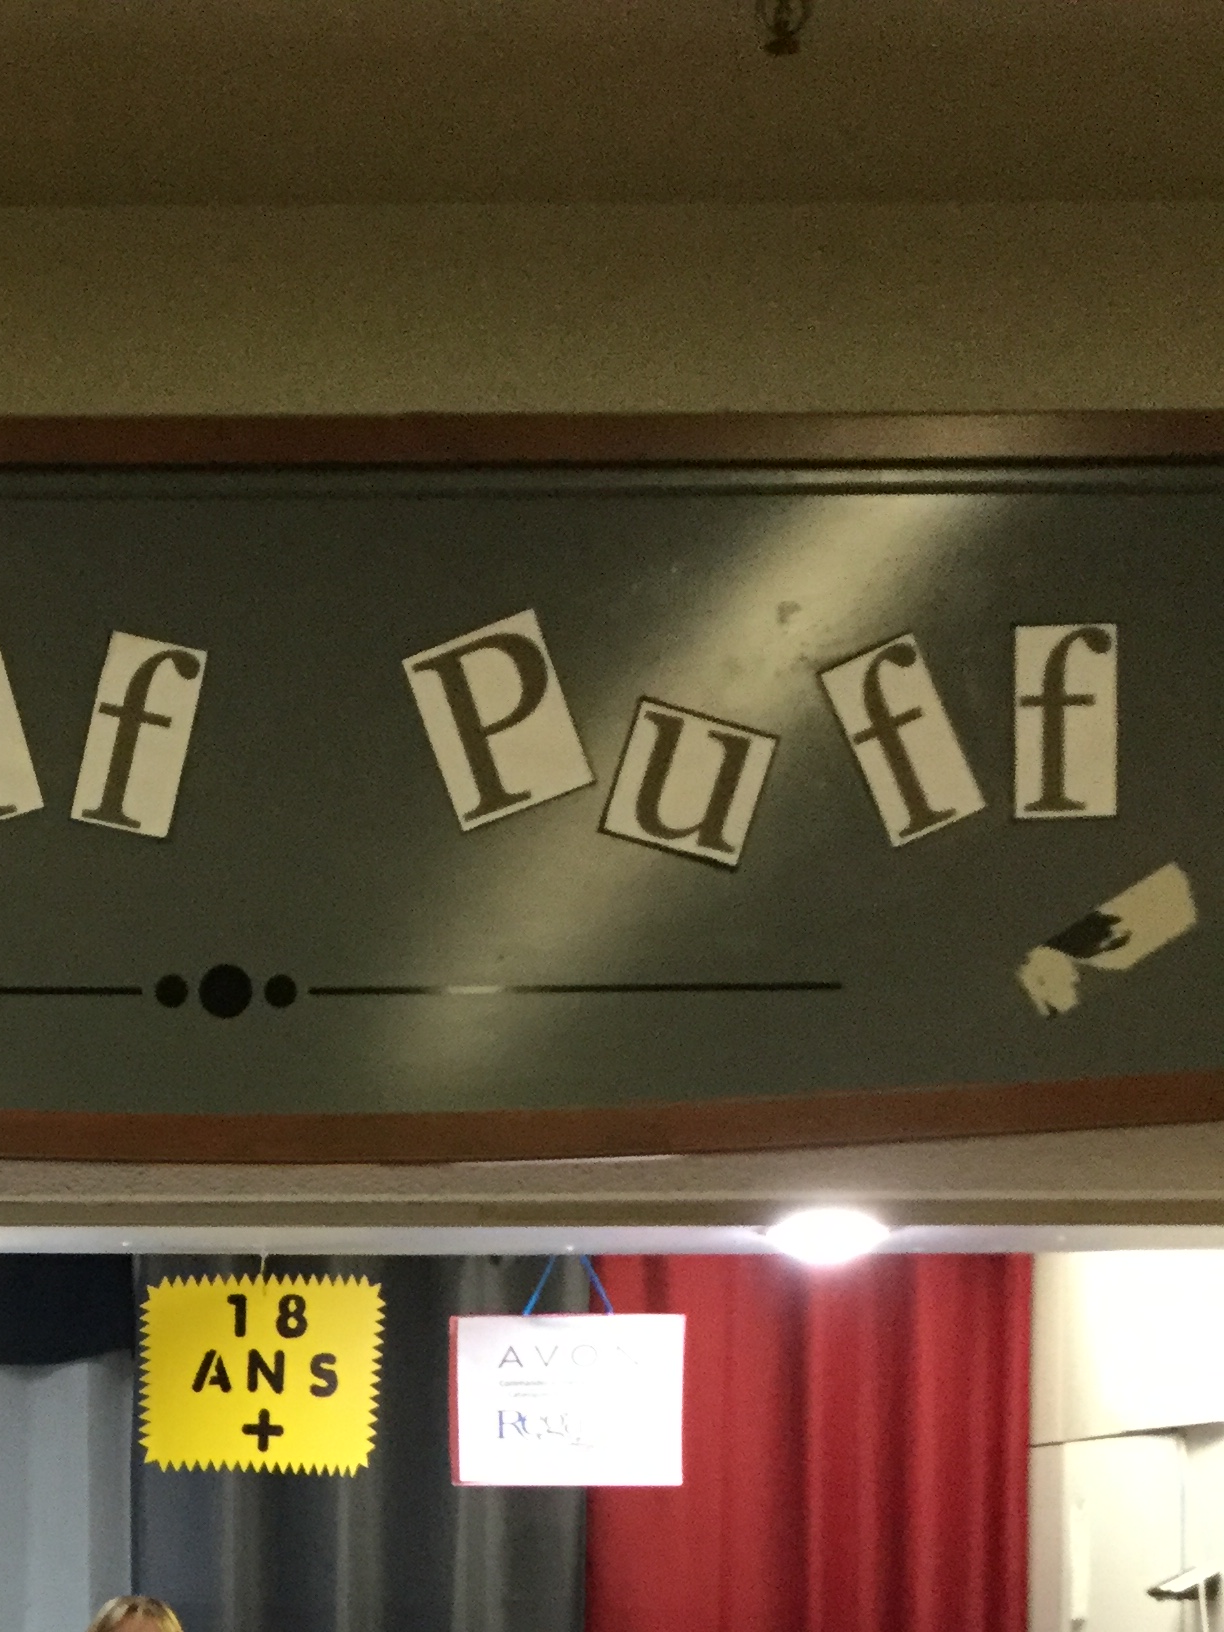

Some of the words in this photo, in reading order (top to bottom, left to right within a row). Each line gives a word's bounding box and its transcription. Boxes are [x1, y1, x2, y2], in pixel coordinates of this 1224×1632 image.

[412, 624, 1113, 856] Puff
[227, 1294, 308, 1339] 18
[192, 1349, 338, 1397] ANS
[242, 1409, 284, 1452] +
